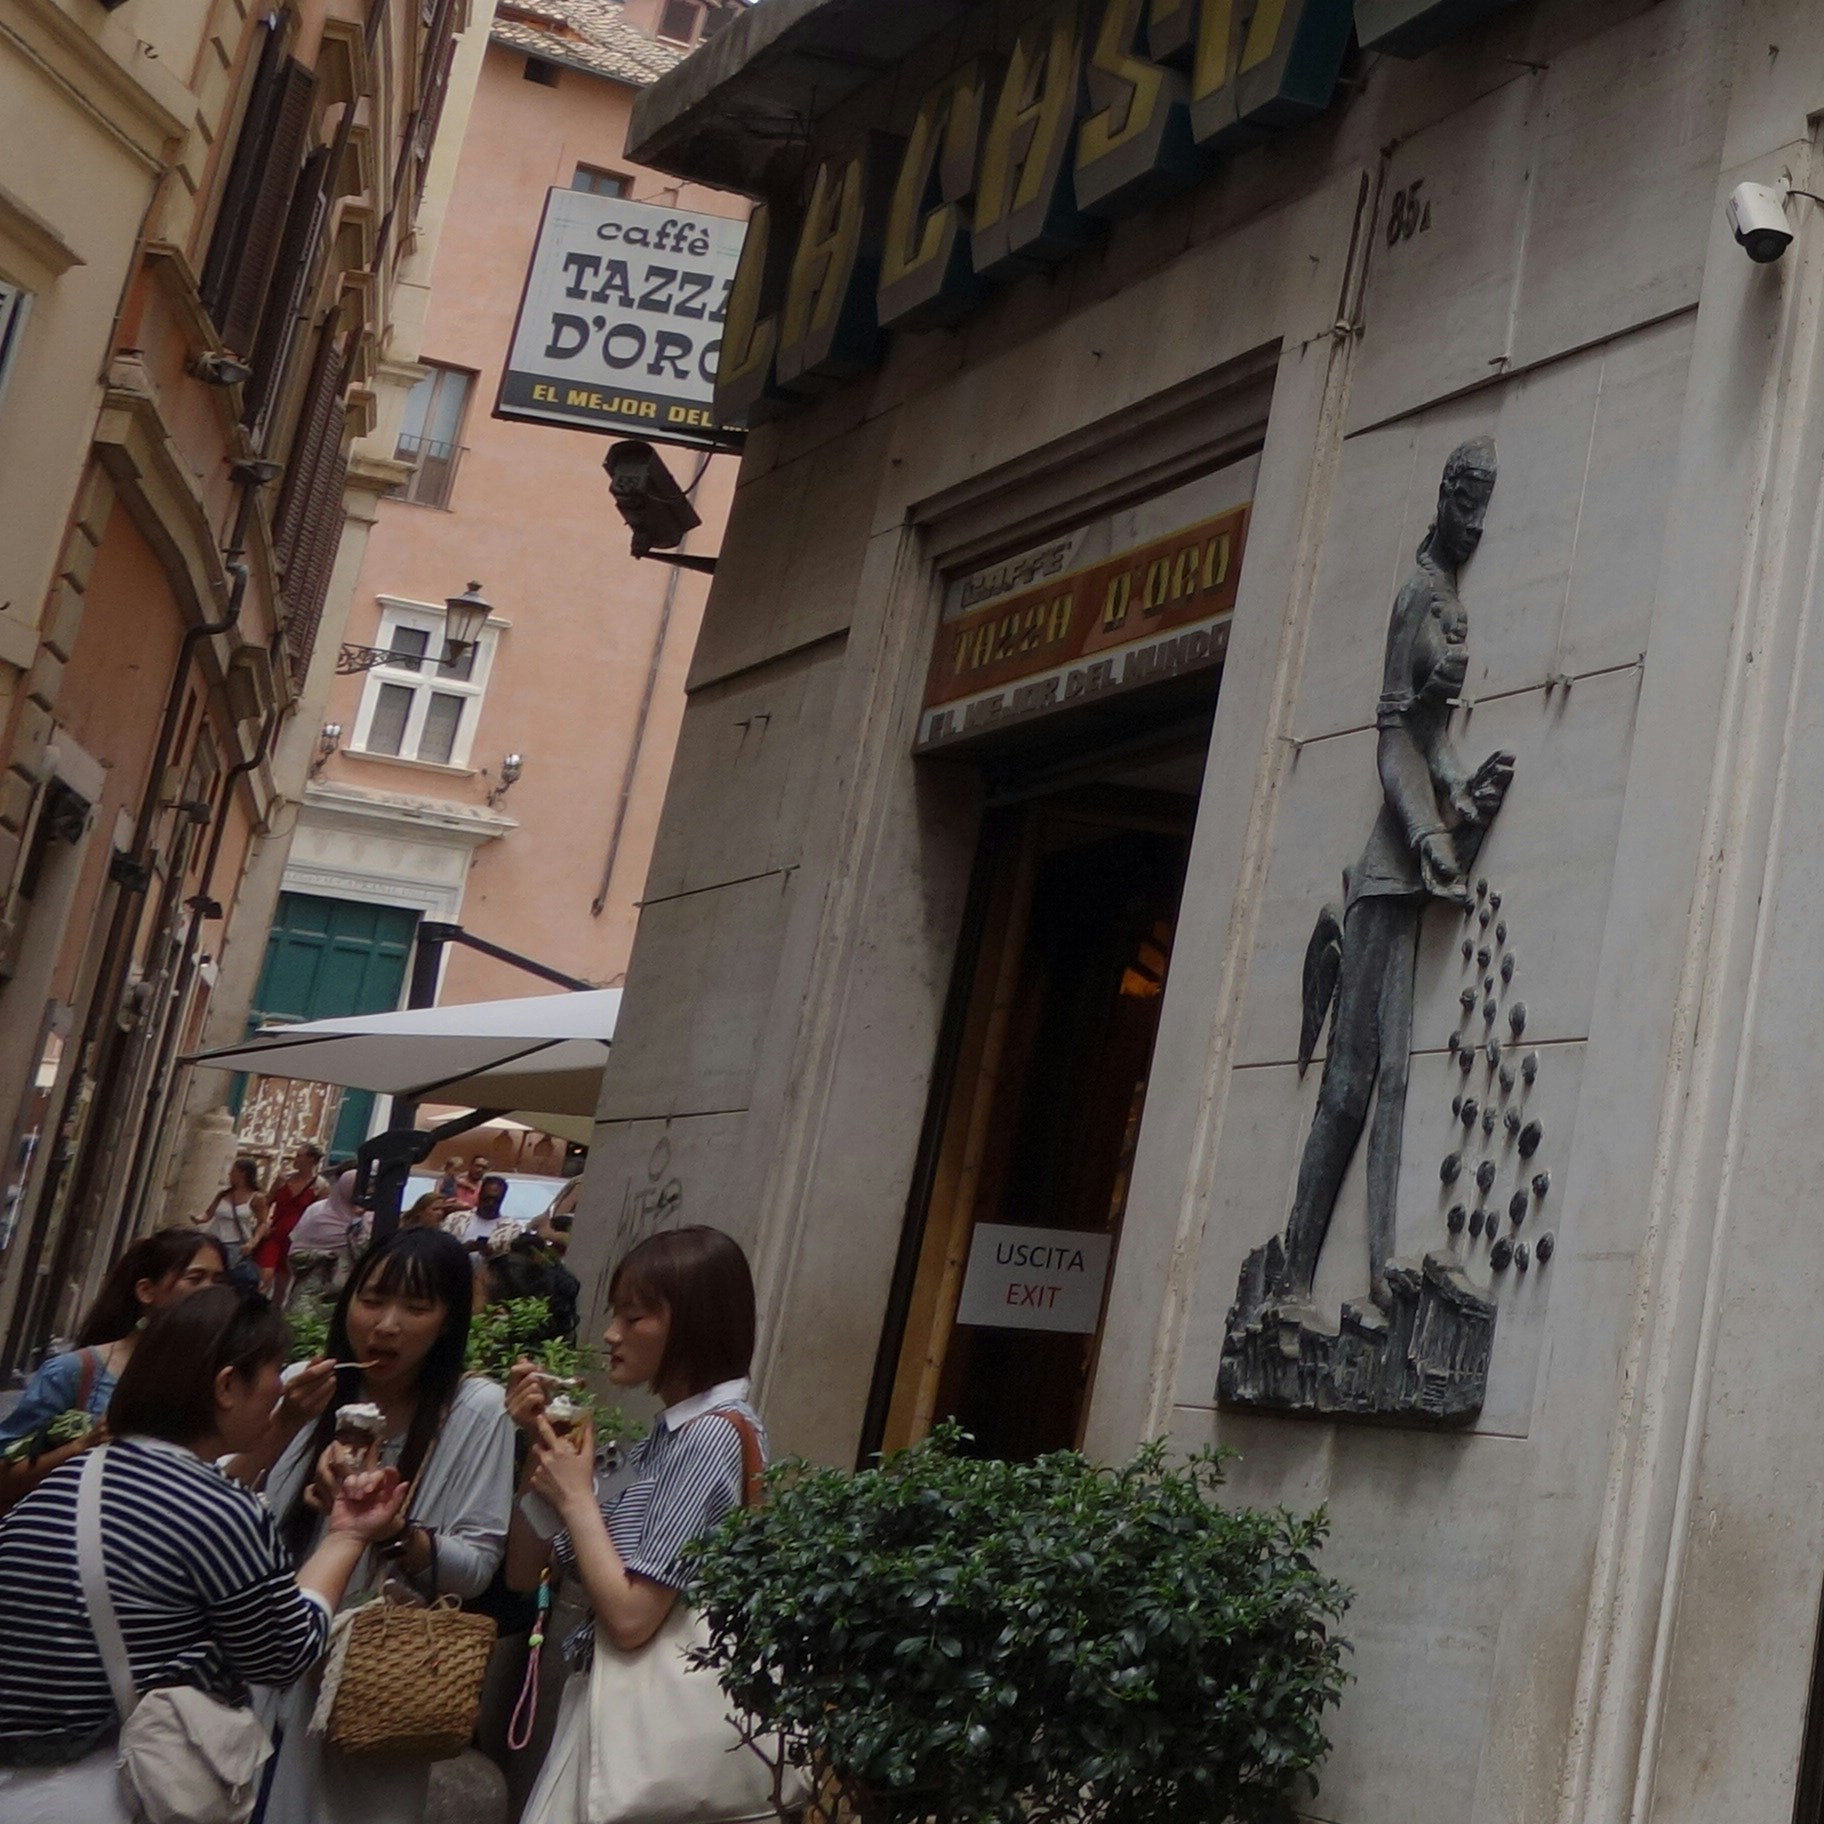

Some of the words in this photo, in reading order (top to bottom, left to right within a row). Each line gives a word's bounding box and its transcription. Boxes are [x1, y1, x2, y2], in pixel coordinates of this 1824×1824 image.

[596, 218, 710, 257] caffè
[532, 383, 559, 403] EL
[566, 388, 658, 419] MEJOR
[667, 405, 713, 427] DEL
[954, 591, 1075, 676] TAZZA
[1101, 531, 1231, 634] D'ORO
[963, 677, 1060, 726] MEJOR
[1064, 659, 1119, 701] DEL
[996, 1242, 1085, 1272] USCITA
[1006, 1283, 1062, 1308] EXIT
